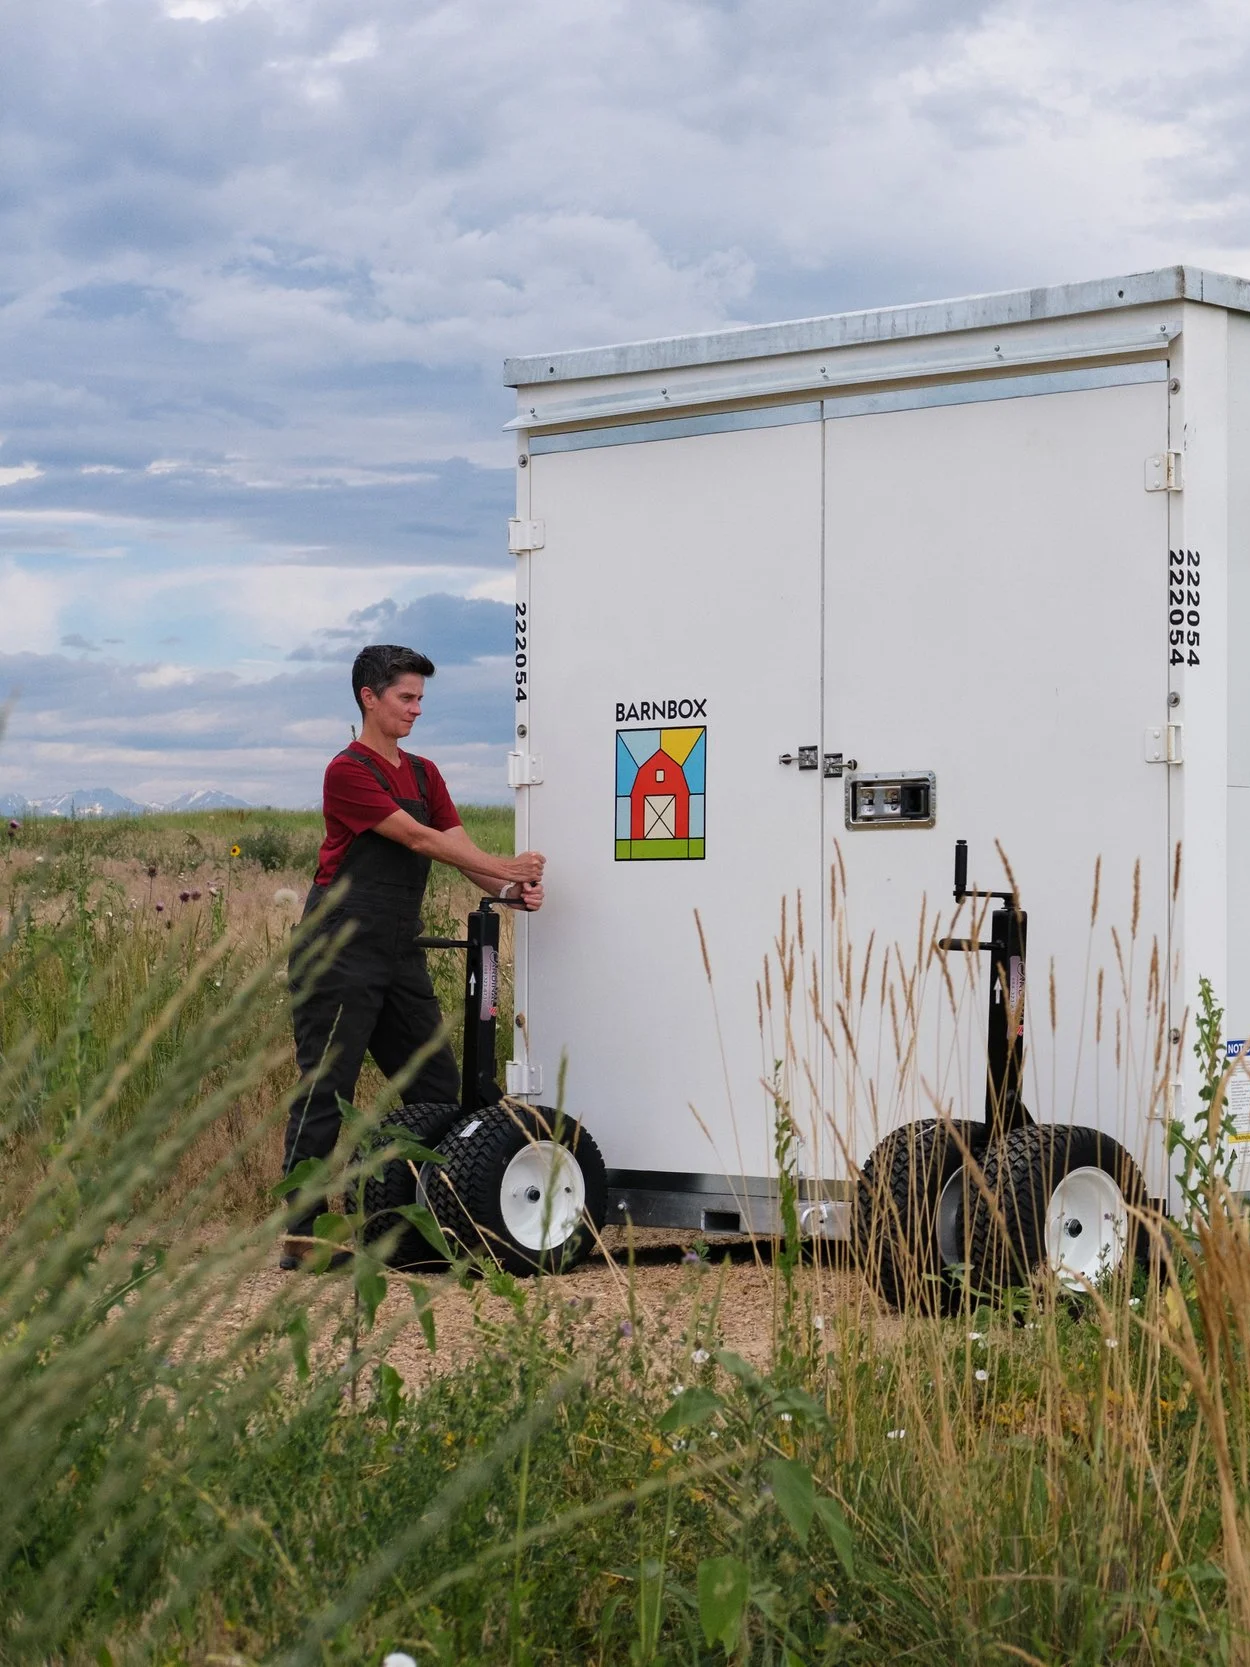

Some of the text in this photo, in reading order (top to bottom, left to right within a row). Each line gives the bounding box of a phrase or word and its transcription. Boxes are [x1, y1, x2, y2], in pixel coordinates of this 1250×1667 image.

[515, 602, 527, 703] 222054
[1169, 549, 1185, 667] 222054
[1186, 549, 1201, 667] 222054
[615, 698, 708, 722] BARNBOX
[490, 951, 498, 1006] CARDINAL
